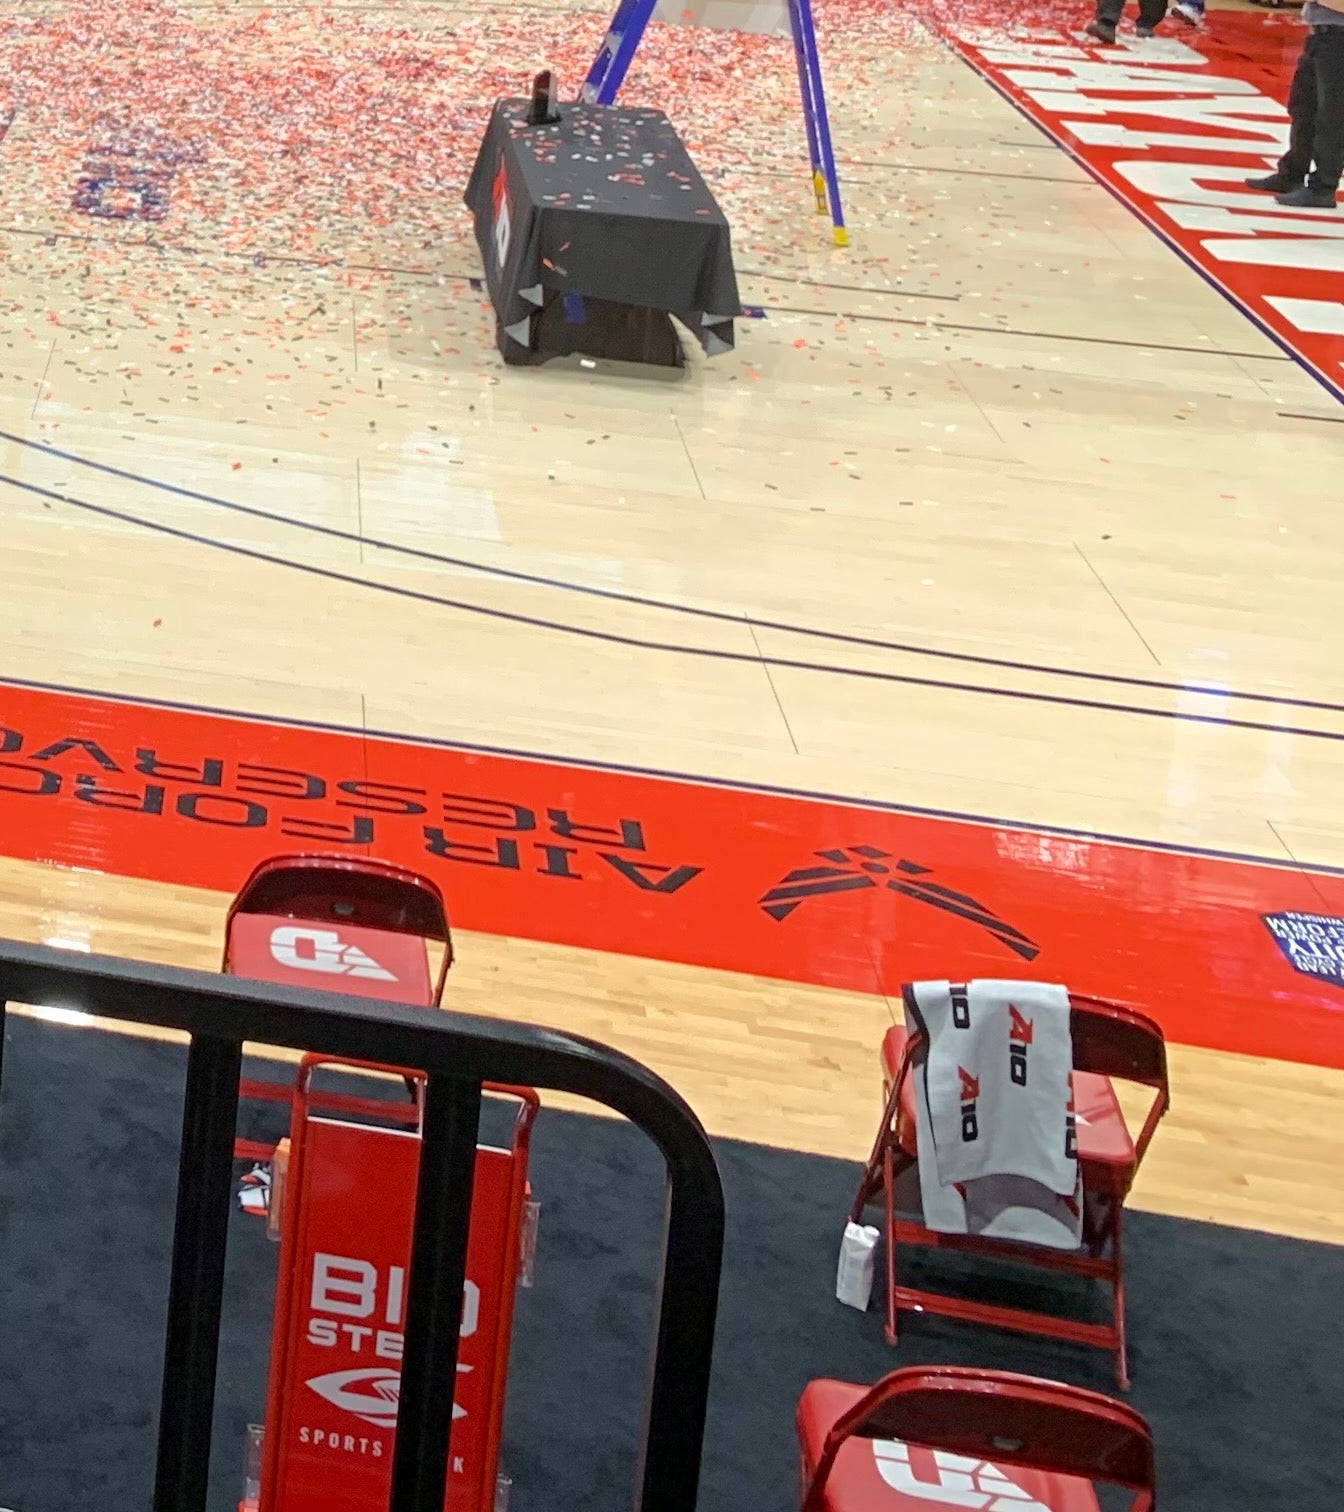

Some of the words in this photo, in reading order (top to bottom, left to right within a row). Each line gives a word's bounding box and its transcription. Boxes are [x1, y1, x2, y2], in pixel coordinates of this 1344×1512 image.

[424, 825, 707, 895] AIR
[1009, 1003, 1034, 1087] A10
[958, 1065, 980, 1143] A10
[299, 1416, 383, 1457] SPORTS
